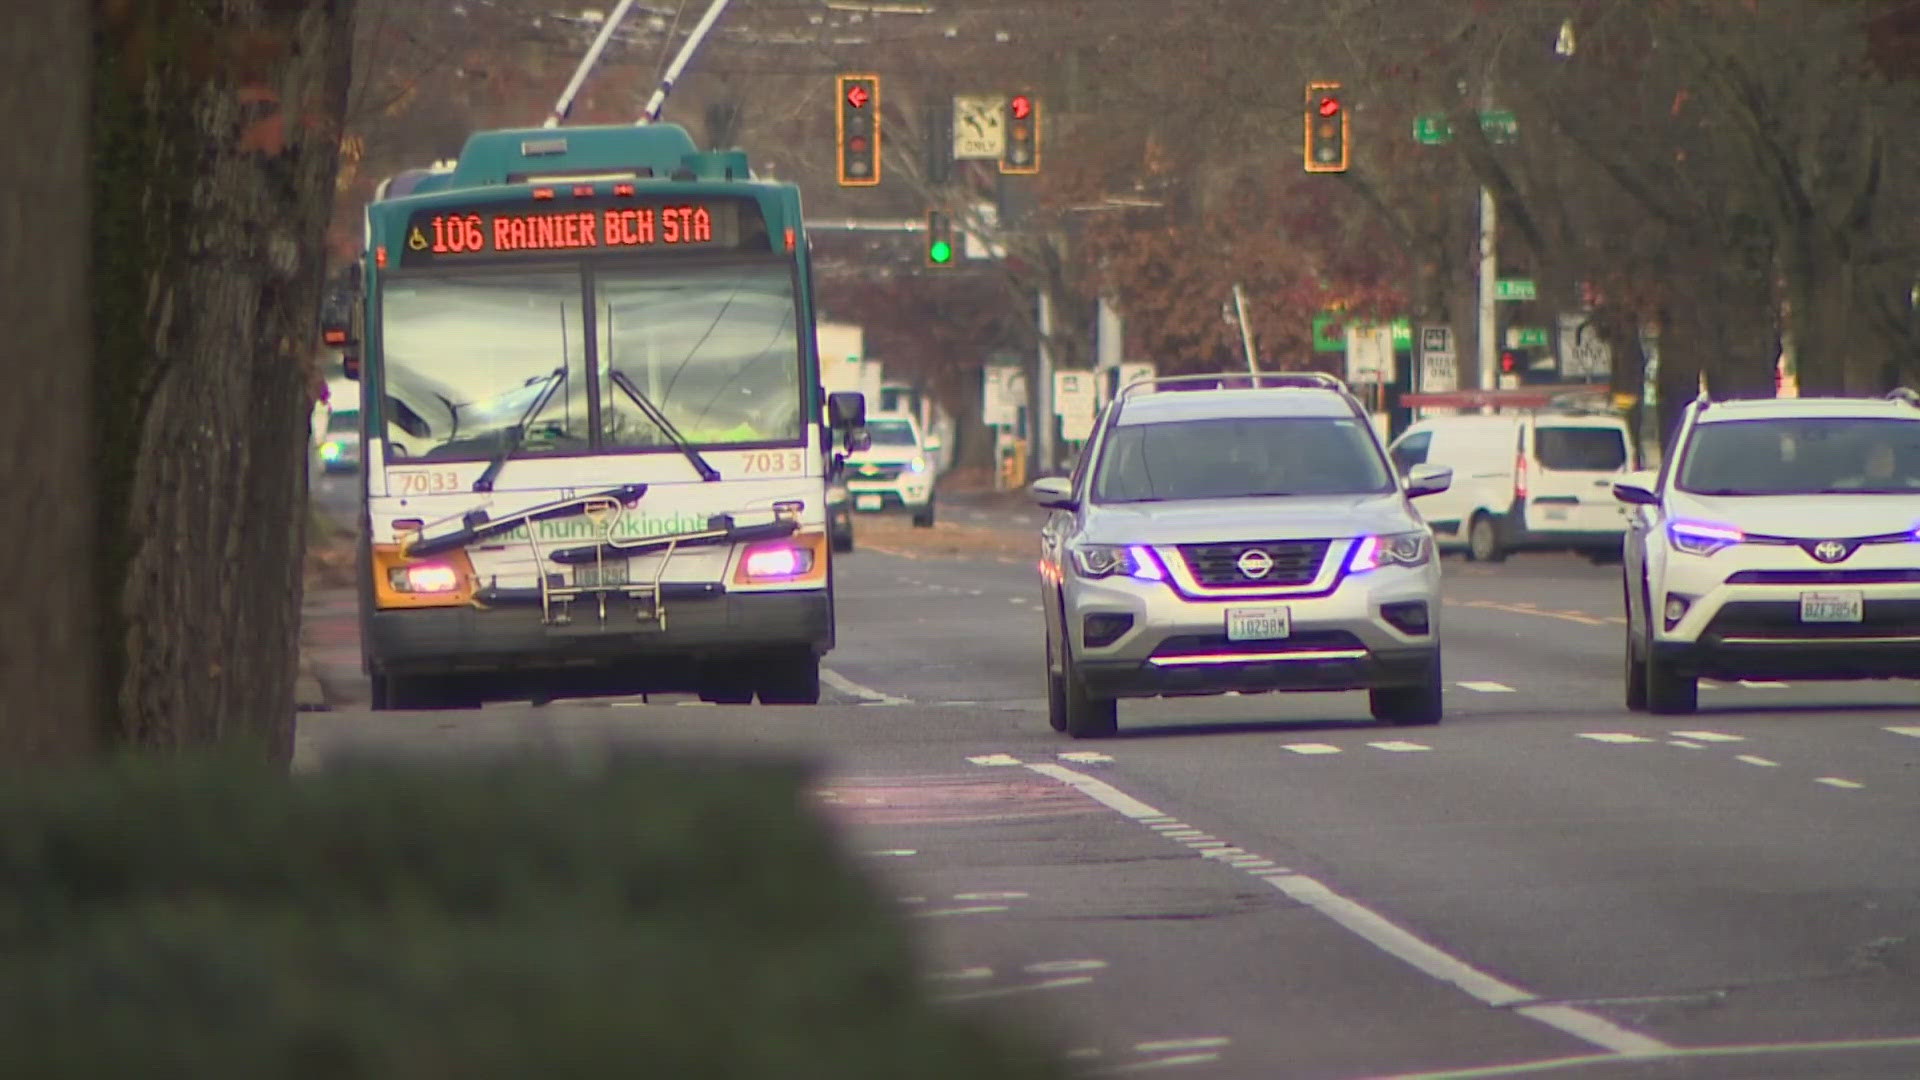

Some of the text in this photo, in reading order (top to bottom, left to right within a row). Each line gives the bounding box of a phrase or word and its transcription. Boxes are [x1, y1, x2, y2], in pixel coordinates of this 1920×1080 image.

[431, 207, 712, 253] 106 RAINIER BCH STA
[742, 452, 802, 473] 7033
[401, 471, 459, 497] 7033
